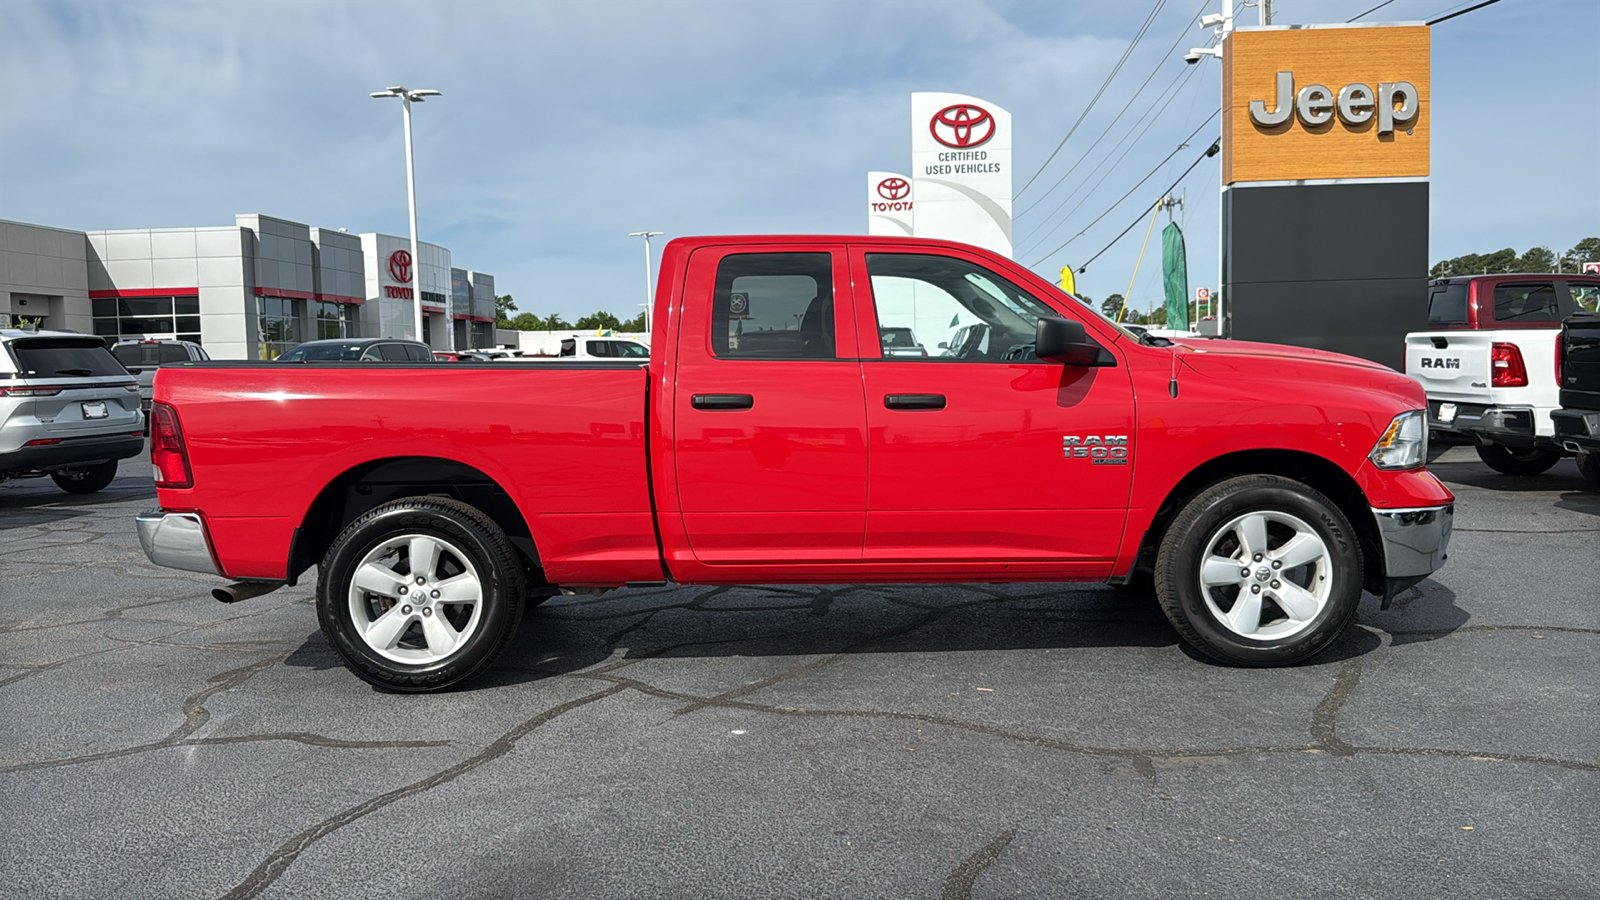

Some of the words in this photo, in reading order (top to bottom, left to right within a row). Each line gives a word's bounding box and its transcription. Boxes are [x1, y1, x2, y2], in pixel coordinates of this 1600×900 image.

[1248, 71, 1419, 134] Jeep
[938, 151, 987, 162] CERTIFIED
[925, 164, 952, 175] USED
[954, 163, 1000, 174] VEHICLES
[871, 201, 913, 212] TOYOTA
[385, 285, 415, 300] TOYOT
[1421, 357, 1460, 369] RAM
[1063, 435, 1128, 446] RAM
[1063, 447, 1128, 458] 1500
